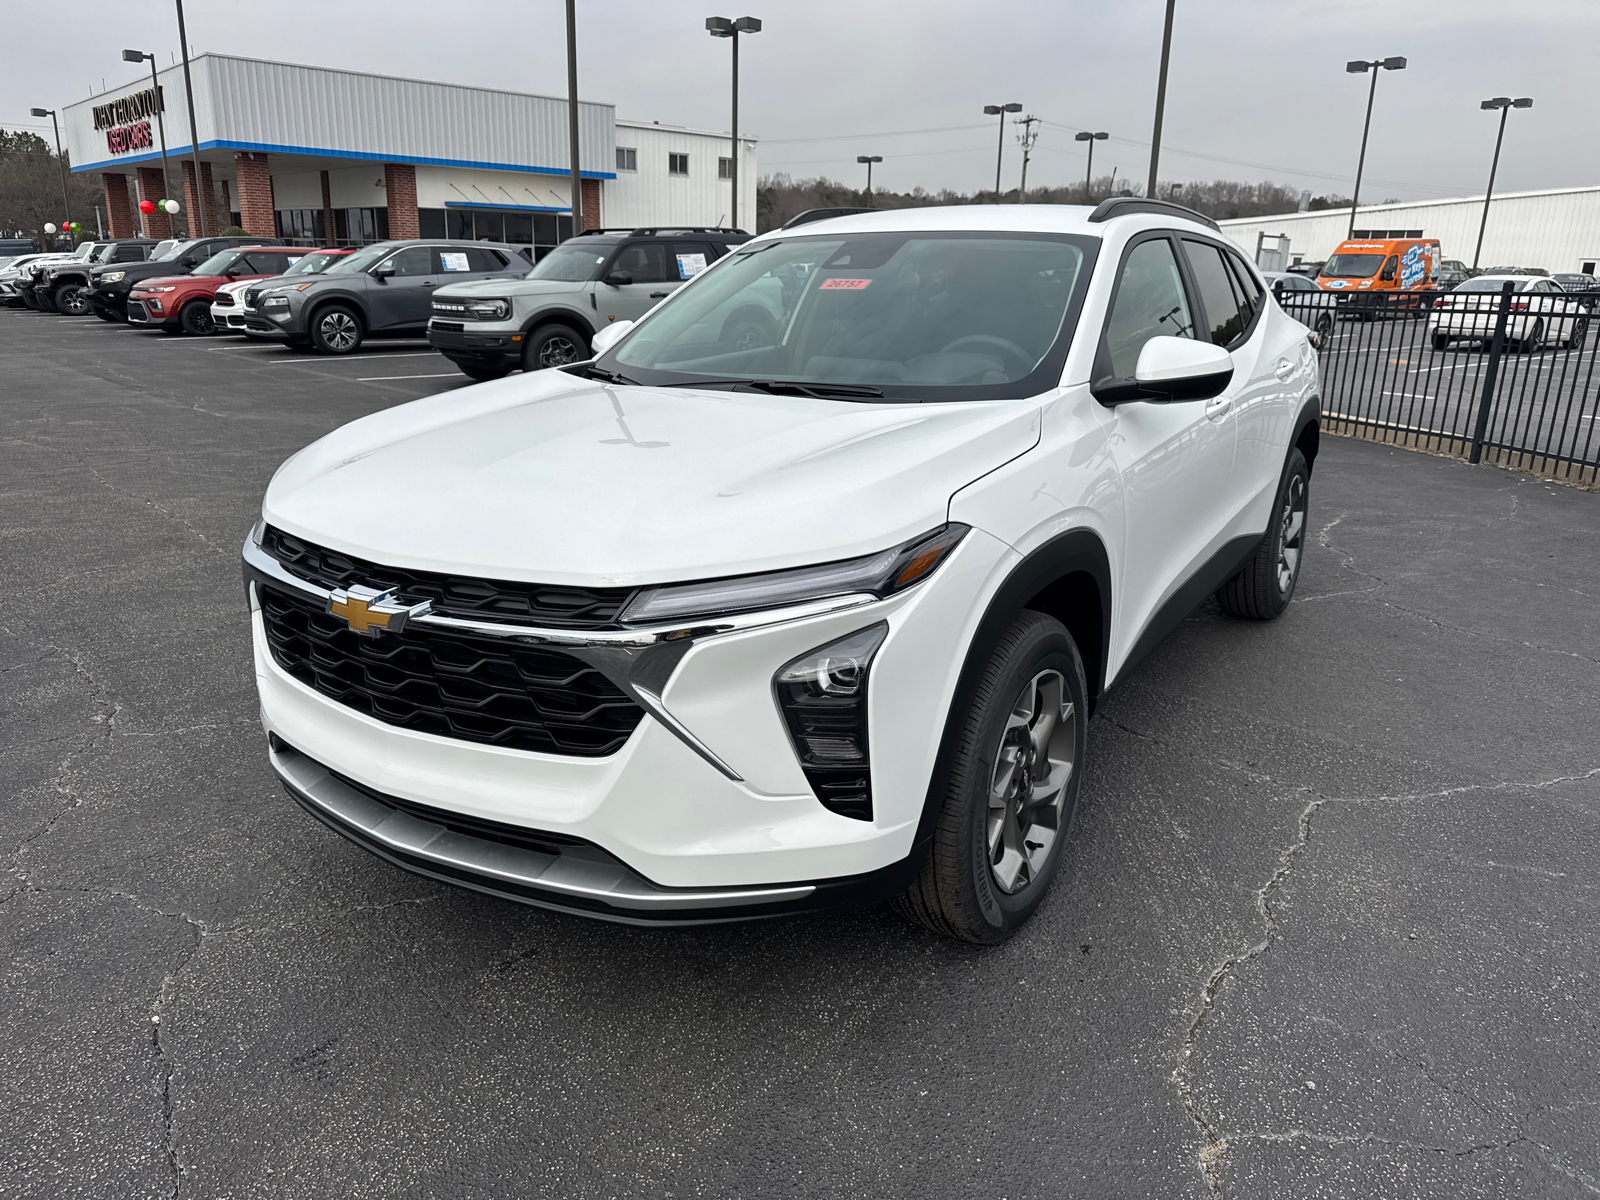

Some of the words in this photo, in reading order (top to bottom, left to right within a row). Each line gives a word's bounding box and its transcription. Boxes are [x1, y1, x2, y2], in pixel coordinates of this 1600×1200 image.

[106, 127, 128, 153] USED
[126, 121, 153, 150] CARS
[1401, 267, 1412, 279] Car
[1411, 259, 1425, 275] Keys
[1401, 270, 1424, 290] Express
